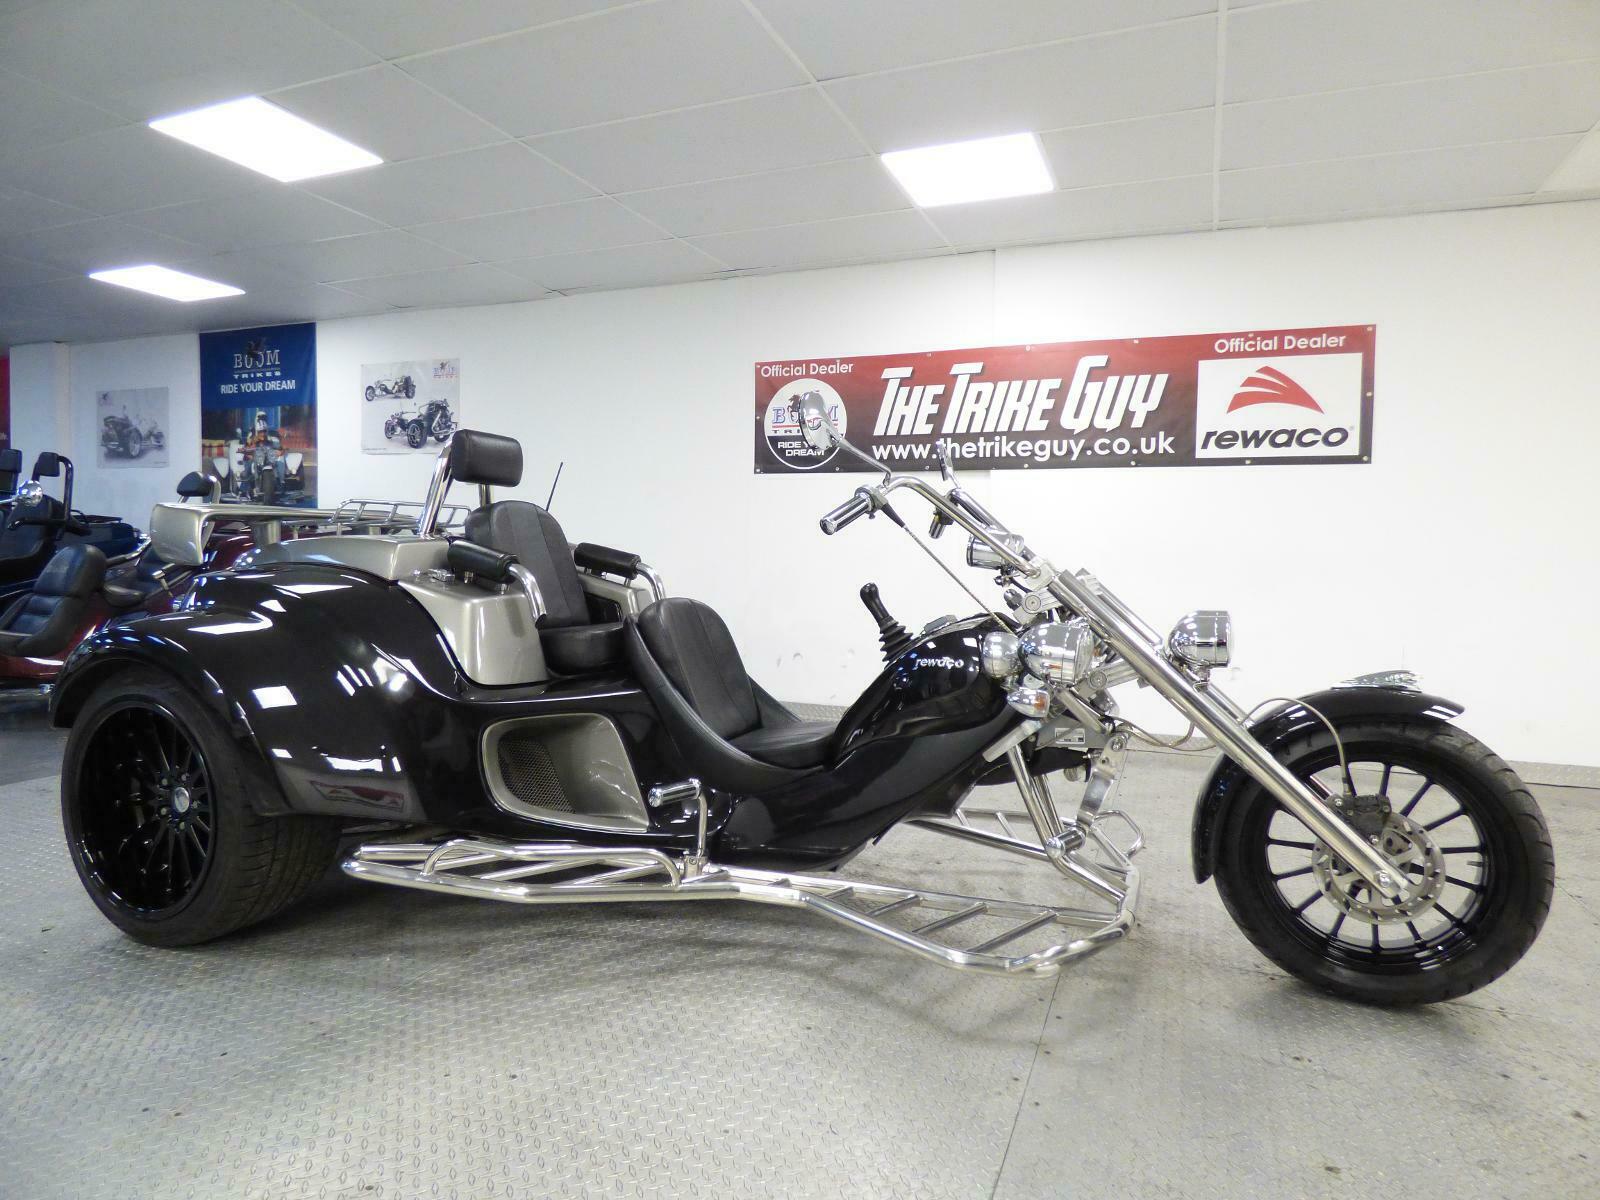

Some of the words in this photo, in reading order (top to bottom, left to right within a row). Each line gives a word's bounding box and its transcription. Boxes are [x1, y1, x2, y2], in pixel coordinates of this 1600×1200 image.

[1214, 336, 1278, 353] Official
[1284, 333, 1347, 350] Dealer
[233, 349, 281, 369] BOOM
[233, 371, 282, 379] TRIKES
[761, 363, 806, 378] Official
[809, 361, 854, 375] Dealer
[221, 383, 239, 394] RIDE
[241, 381, 264, 393] YOUR
[265, 379, 296, 391] DREAM
[772, 405, 839, 424] BOM
[778, 441, 801, 449] RIDE
[1201, 426, 1349, 450] rewaco
[786, 449, 825, 457] DREAM
[914, 657, 965, 669] rewaco
